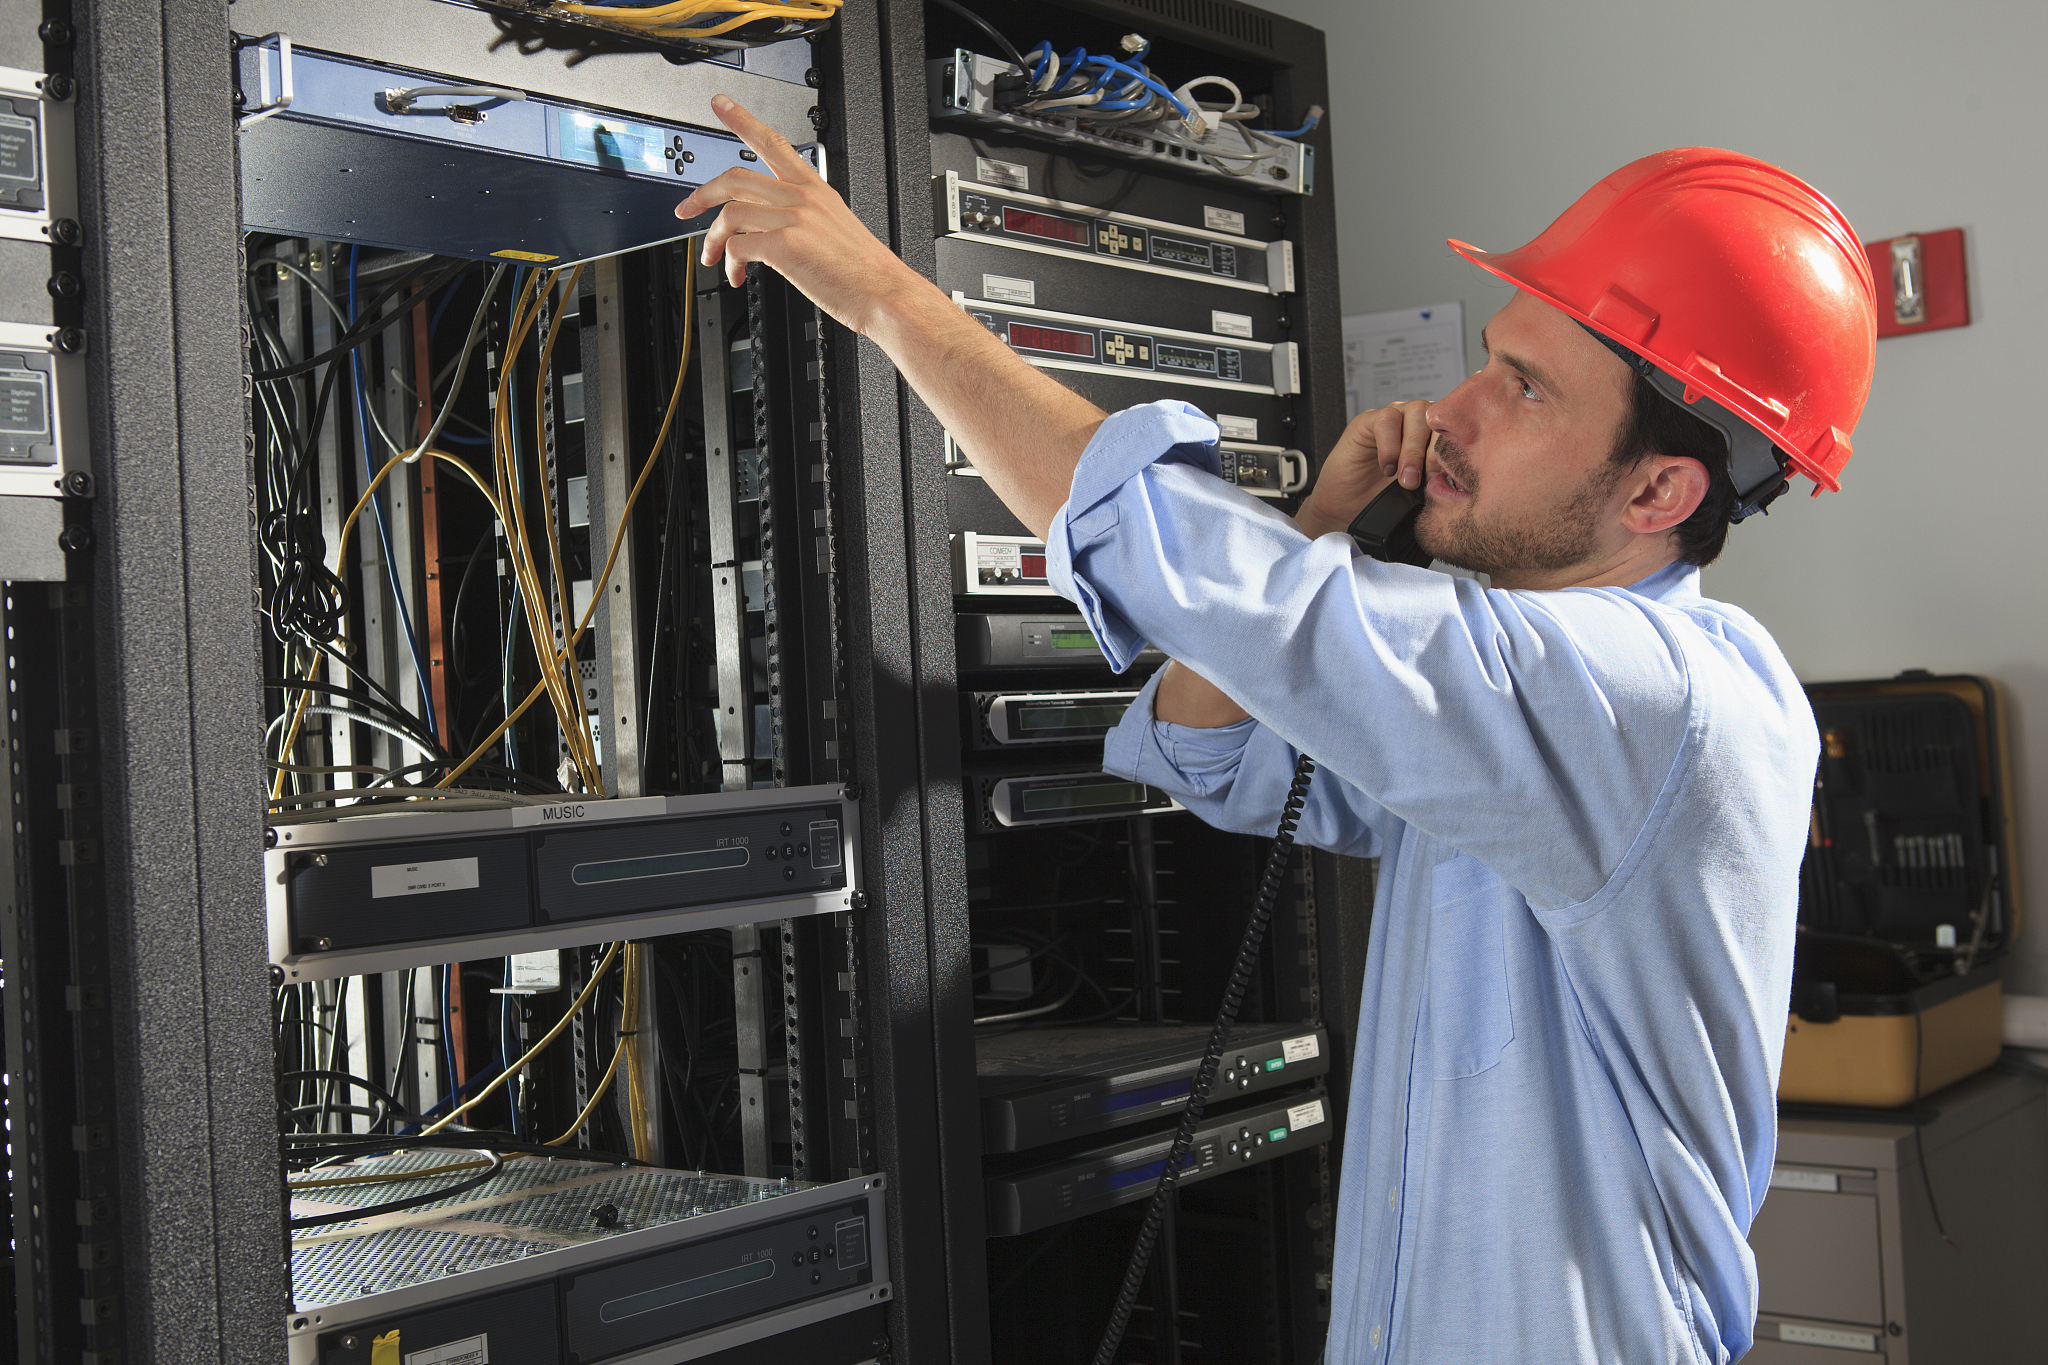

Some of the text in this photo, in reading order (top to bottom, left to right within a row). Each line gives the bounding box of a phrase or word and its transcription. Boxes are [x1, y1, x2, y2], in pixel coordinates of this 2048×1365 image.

[989, 547, 1012, 555] COMEDY
[542, 805, 585, 820] MUSIC
[716, 836, 749, 847] IRT 1000
[786, 847, 791, 855] E
[741, 1248, 773, 1263] IRT 1000
[813, 1252, 818, 1260] E
